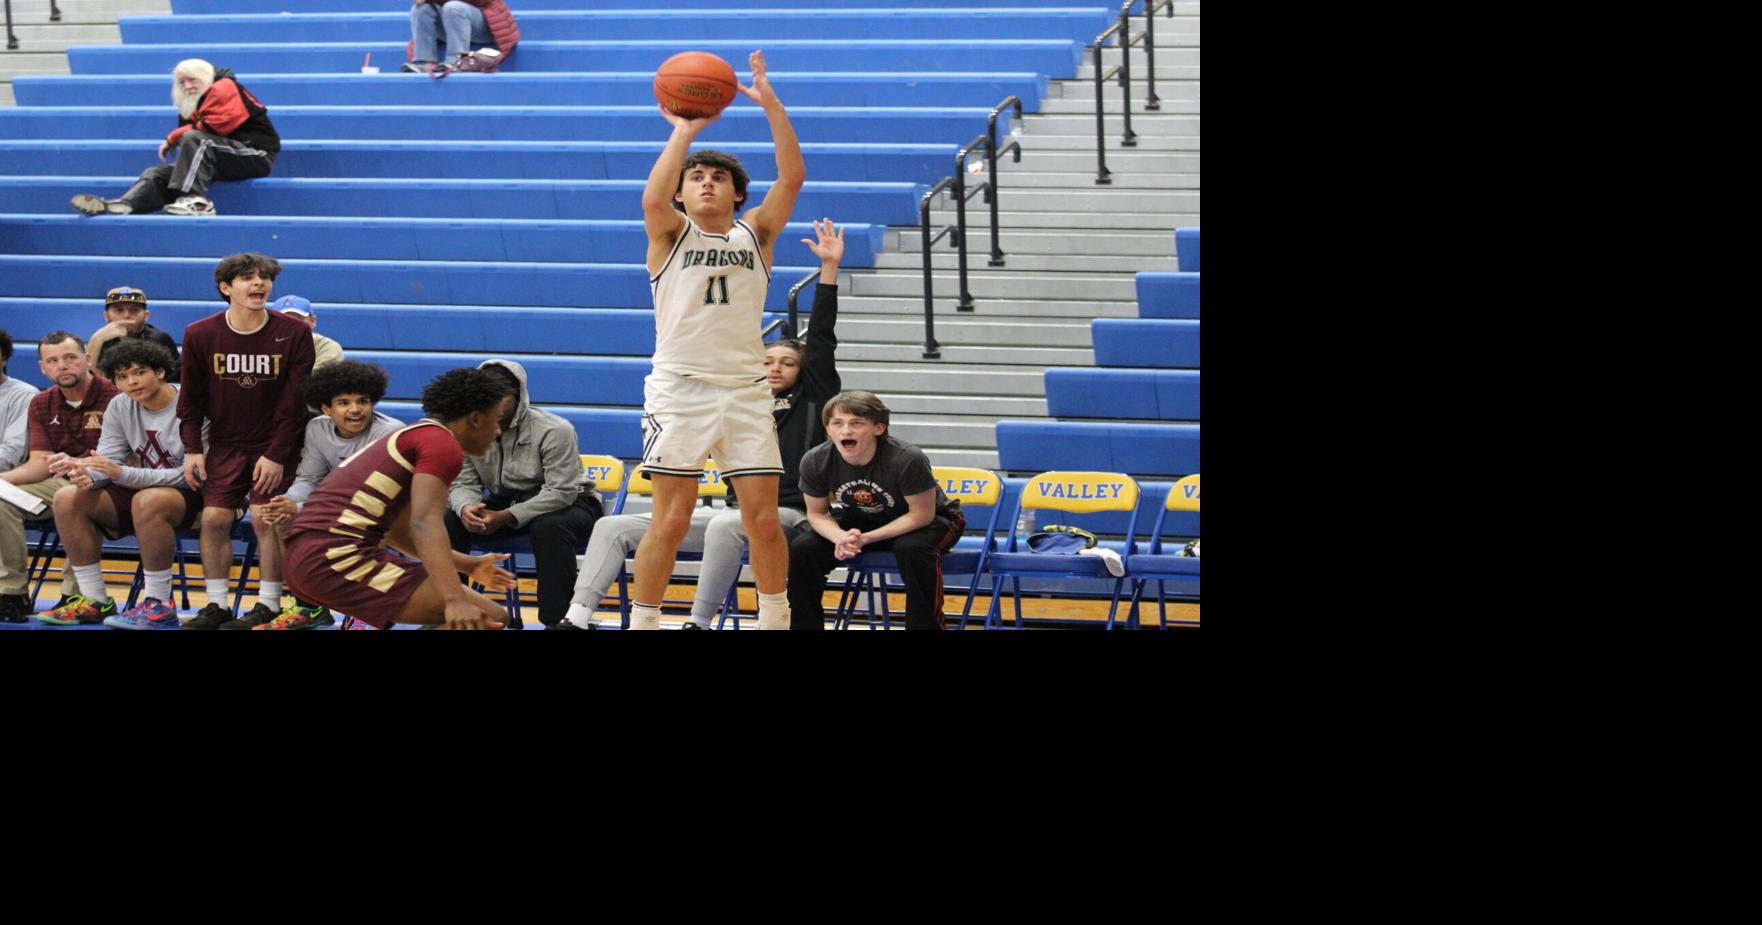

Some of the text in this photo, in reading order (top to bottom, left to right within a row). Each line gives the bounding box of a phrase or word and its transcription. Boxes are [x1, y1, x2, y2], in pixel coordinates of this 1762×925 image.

[681, 248, 755, 271] DRAGONS
[703, 274, 730, 305] 11
[213, 352, 283, 376] COURT
[1038, 481, 1124, 499] VALLEY
